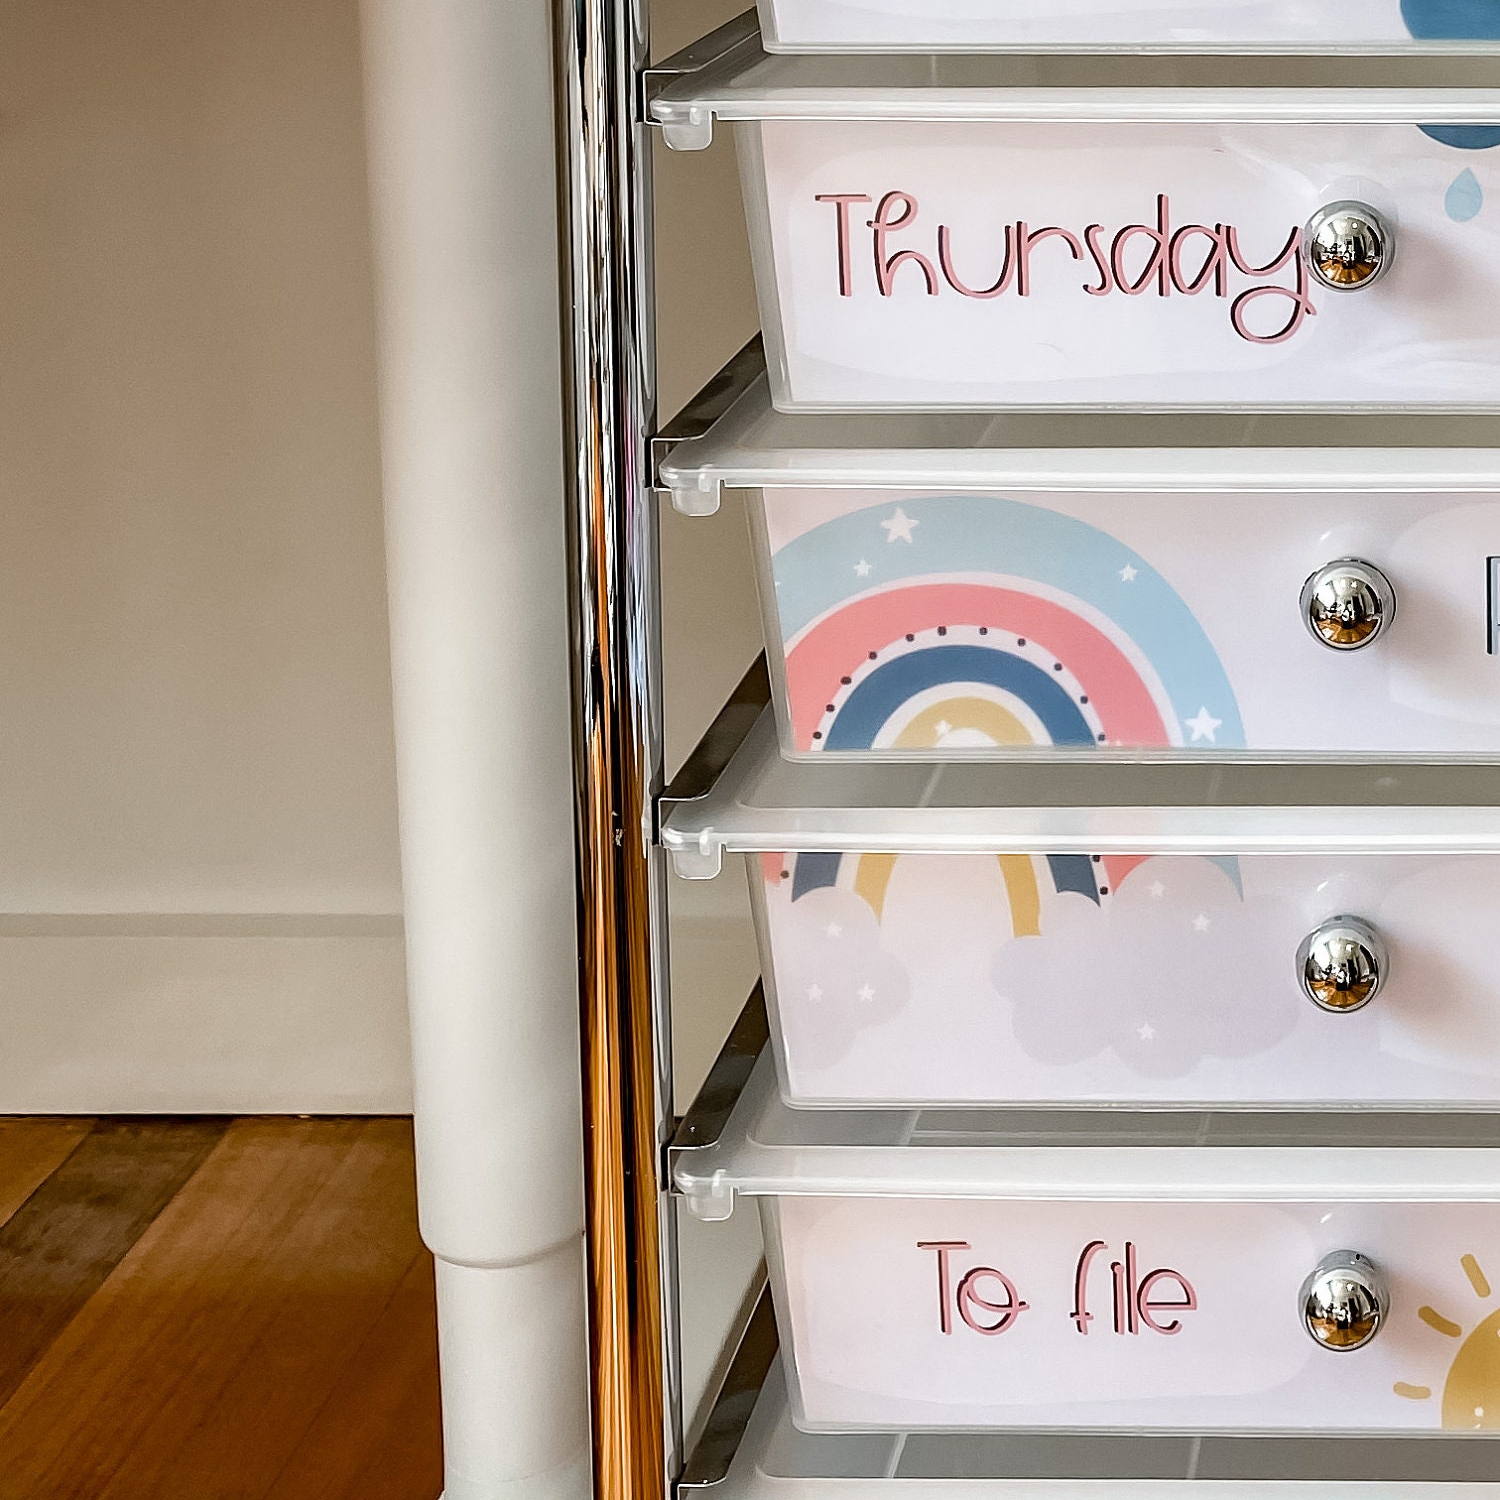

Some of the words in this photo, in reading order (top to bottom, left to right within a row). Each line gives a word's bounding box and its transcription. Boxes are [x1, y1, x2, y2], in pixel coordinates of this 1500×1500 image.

[814, 190, 1317, 345] Thursday
[916, 1240, 1031, 1336] To
[1070, 1240, 1198, 1336] file
